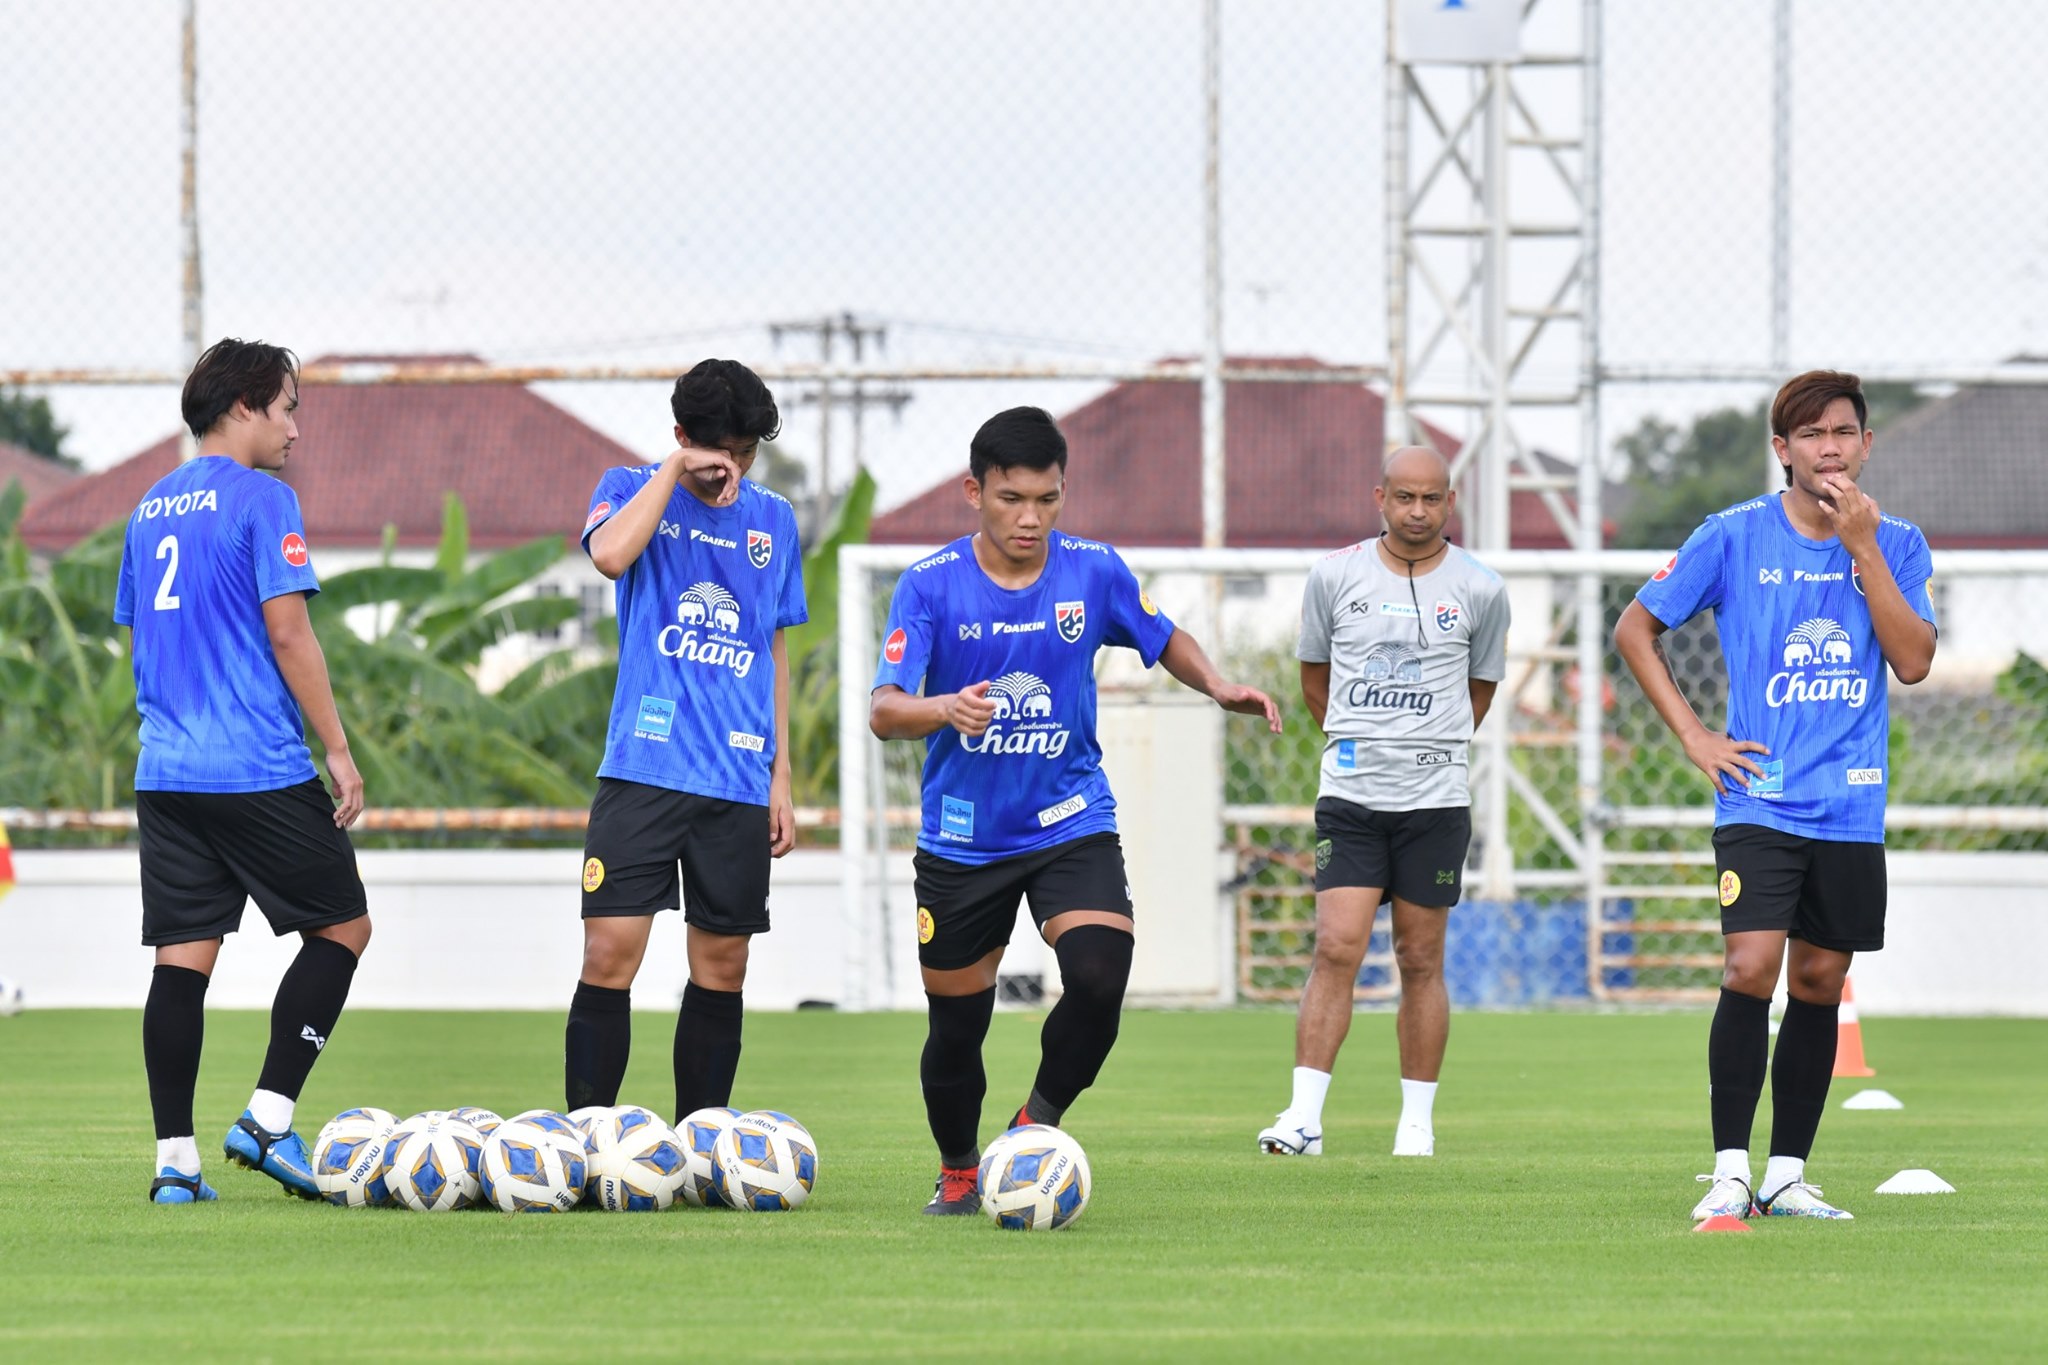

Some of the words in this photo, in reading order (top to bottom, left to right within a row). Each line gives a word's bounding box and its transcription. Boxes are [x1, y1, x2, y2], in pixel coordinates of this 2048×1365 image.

[137, 489, 217, 523] TOYOTA
[1717, 500, 1767, 519] TOYOTA
[699, 533, 737, 550] DAIKIN
[154, 534, 181, 611] 2
[912, 550, 960, 573] TOYOTA
[1803, 571, 1844, 582] DAIKIN
[1003, 621, 1046, 634] DAIKIN
[657, 624, 755, 678] Chang
[1349, 680, 1433, 716] Chang
[1765, 671, 1868, 708] Chang
[730, 734, 764, 750] GATSBY
[1417, 752, 1451, 765] GATSBY
[1848, 771, 1882, 784] GATSBY
[1040, 797, 1084, 825] GATSBY
[739, 1117, 778, 1133] molten
[349, 1145, 381, 1184] molten
[1040, 1155, 1068, 1195] molten
[606, 1180, 617, 1211] molte
